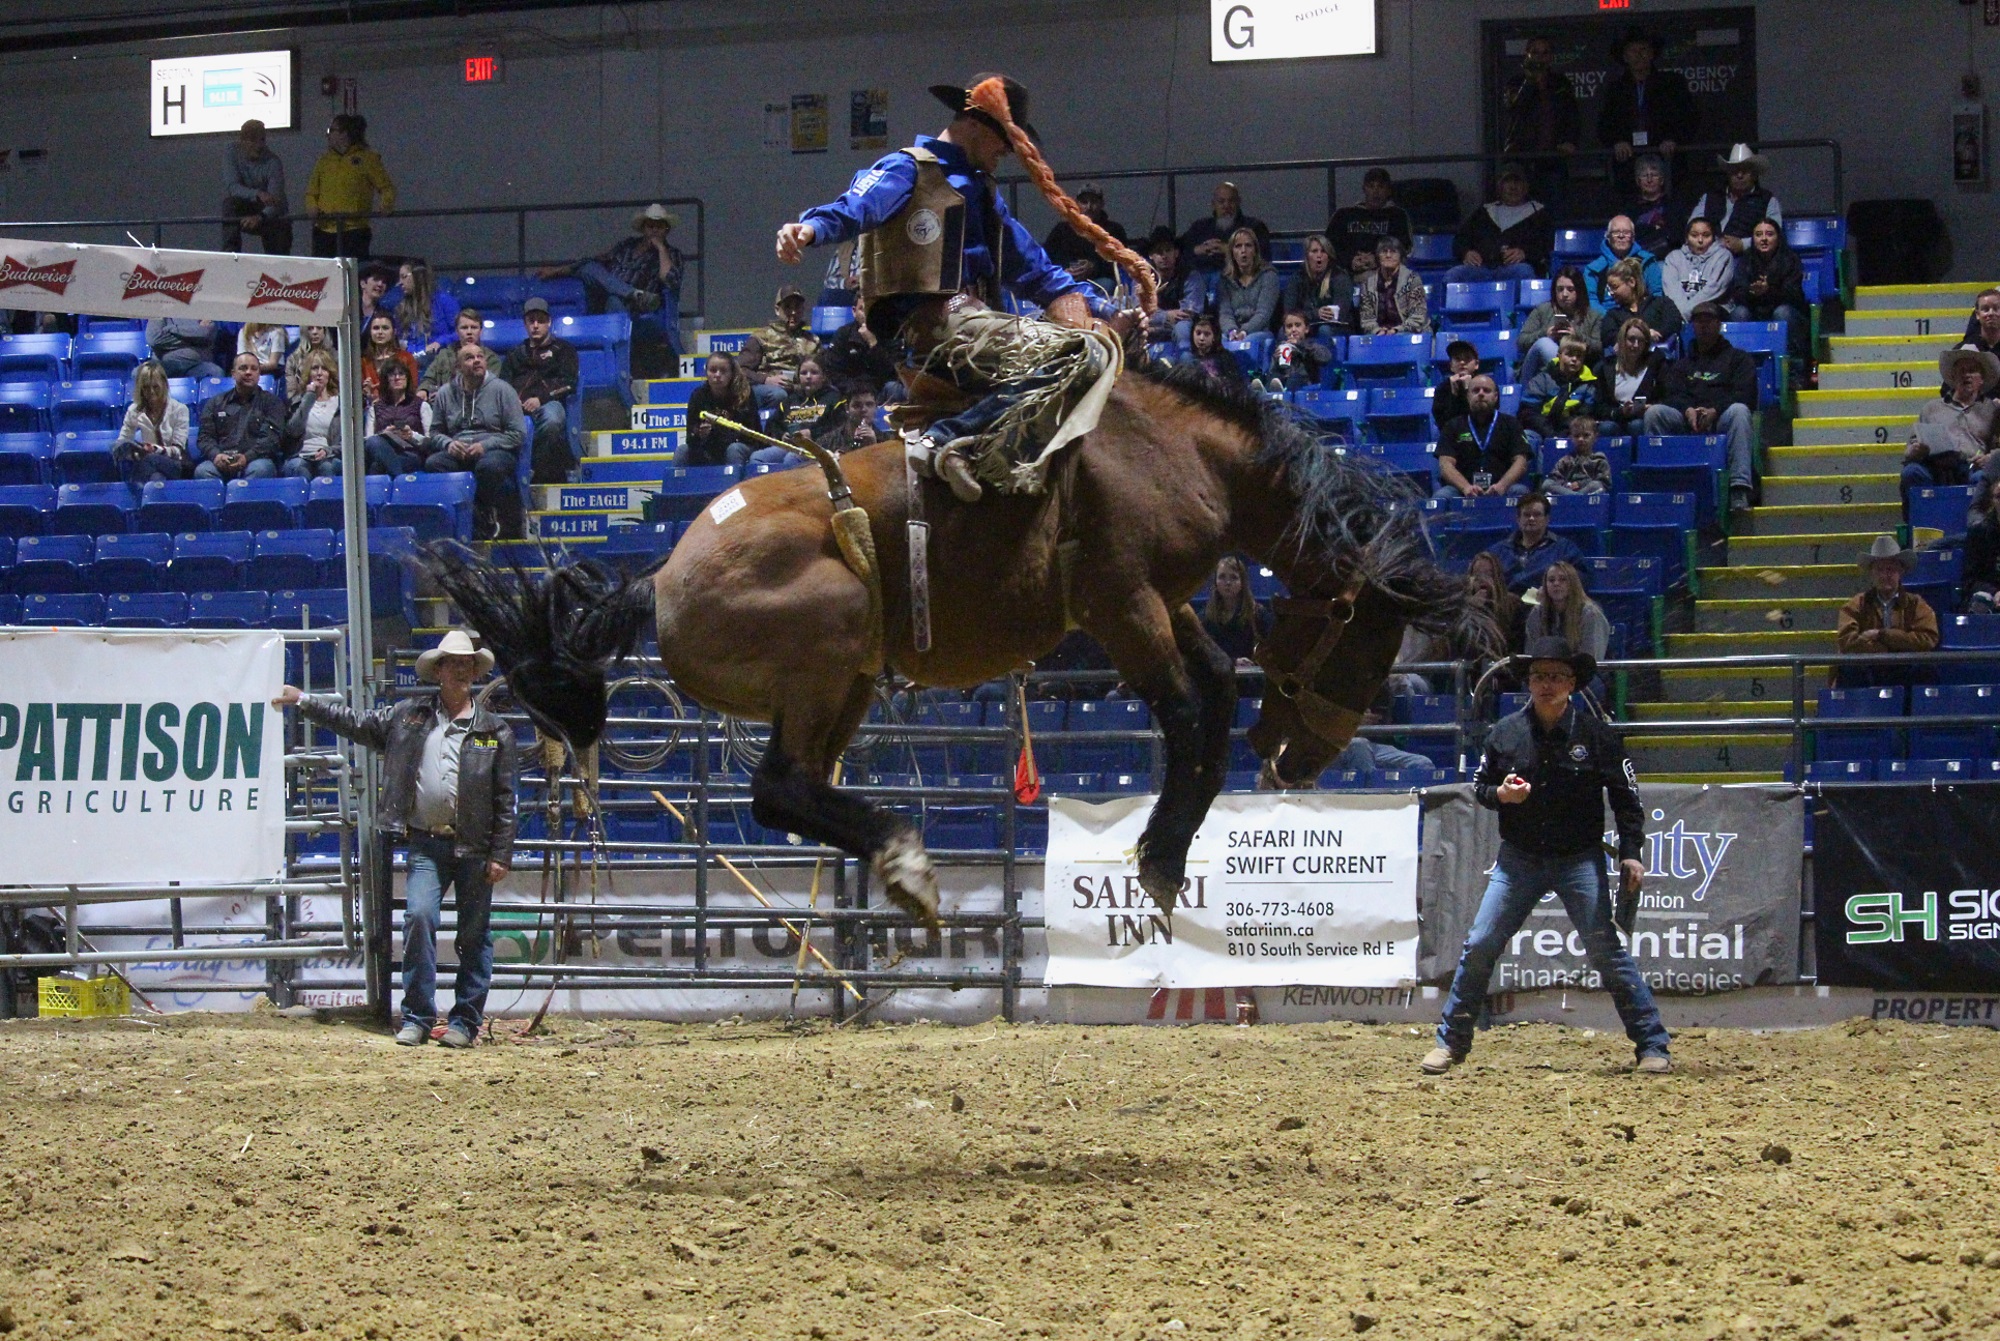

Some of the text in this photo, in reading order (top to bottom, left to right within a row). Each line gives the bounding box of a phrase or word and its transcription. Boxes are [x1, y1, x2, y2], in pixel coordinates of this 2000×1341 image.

[1223, 4, 1255, 50] G
[465, 57, 493, 81] EXIT
[1687, 78, 1728, 93] ONLY
[163, 85, 186, 125] H
[0, 263, 77, 285] Budweiser
[120, 271, 203, 294] Budweiser
[246, 279, 328, 301] Budweiser
[1915, 318, 1930, 336] 11
[711, 341, 734, 352] The
[1891, 370, 1913, 388] 10
[649, 415, 670, 427] The
[621, 437, 668, 451] 94.1 FM
[1875, 426, 1888, 444] 9
[562, 494, 626, 507] The EAGLE
[1840, 485, 1853, 504] 8
[551, 520, 598, 533] 94.1 FM
[1751, 677, 1765, 697] 5
[0, 701, 265, 782] PATTISON
[1717, 745, 1730, 767] 4
[8, 787, 259, 813] GRICULTURE
[1227, 829, 1343, 848] SAFARI INN
[1225, 855, 1387, 875] SWIFT CURRENT
[1225, 902, 1335, 917] 306-773-4608
[1845, 891, 1938, 945] SH
[1105, 913, 1173, 947] INN
[1225, 922, 1314, 938] safariinn.ca
[1227, 942, 1395, 957] 810 South Service Rd E
[1511, 923, 1743, 960] rential
[1500, 963, 1742, 996] Financia rategies
[1282, 986, 1414, 1007] KENWORTH
[1871, 998, 2000, 1020] PROPERT
